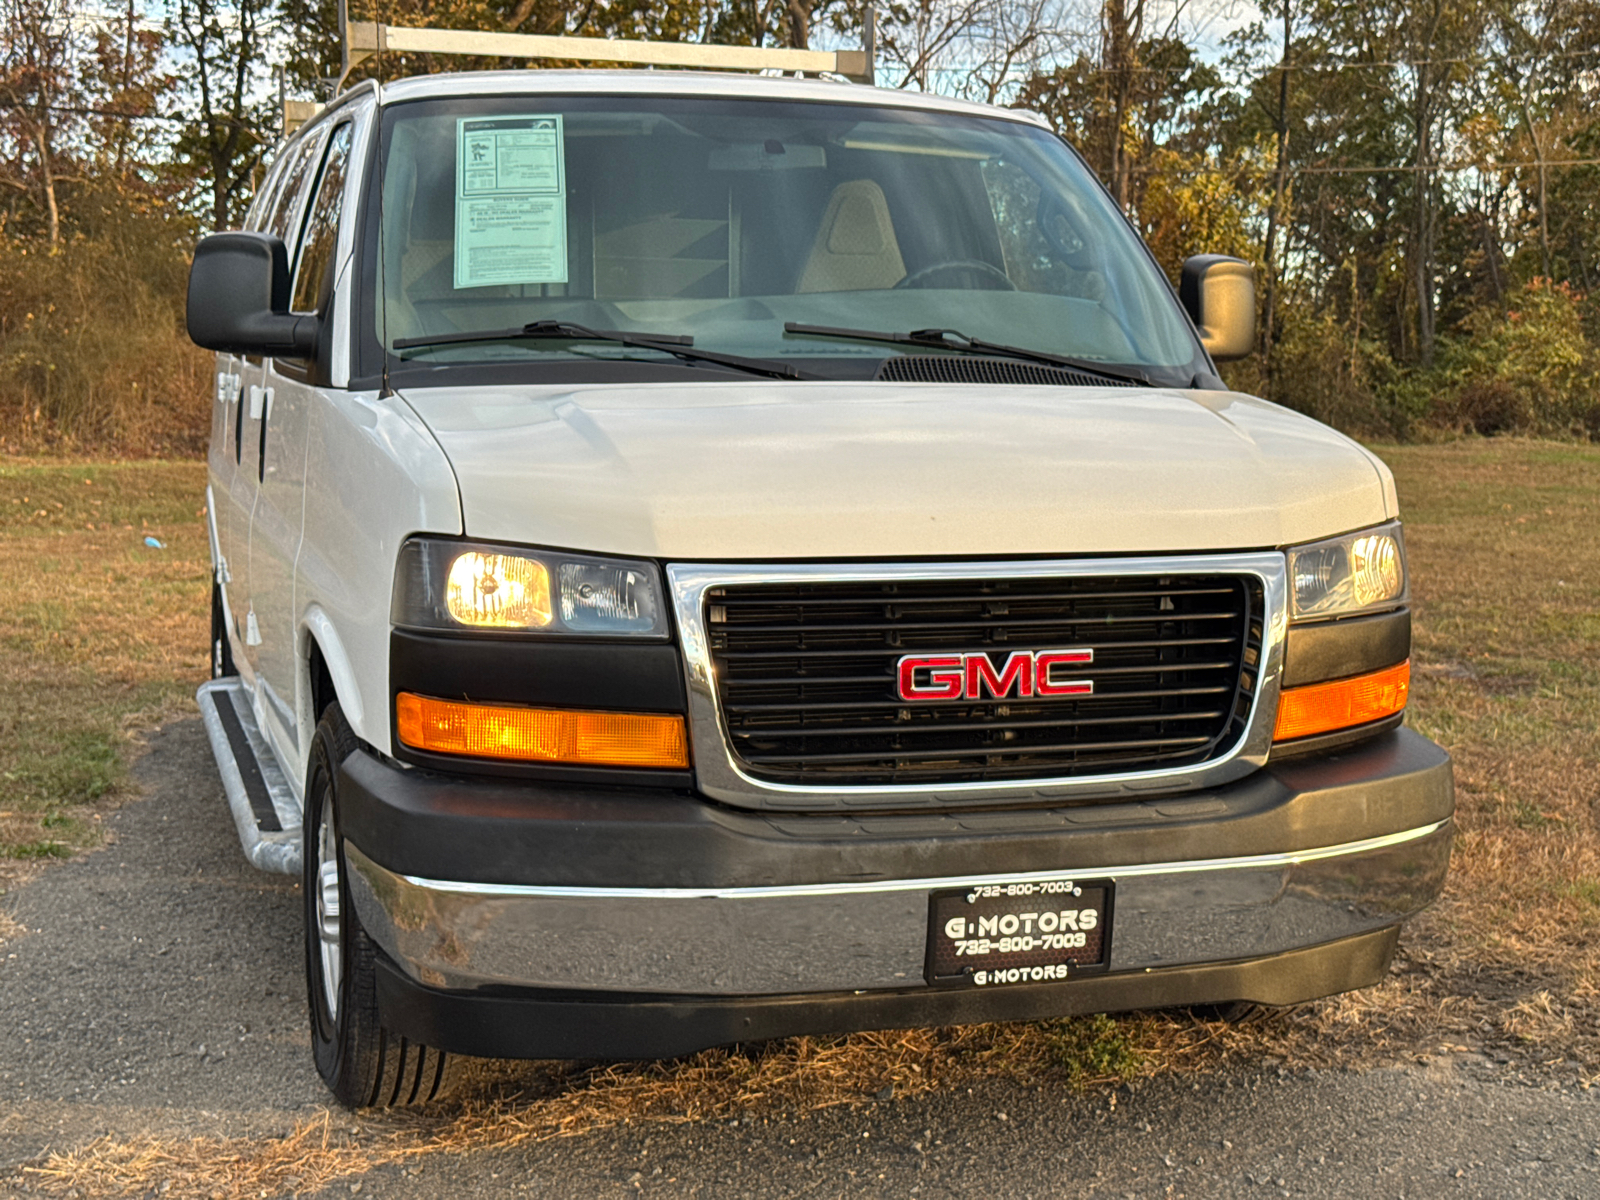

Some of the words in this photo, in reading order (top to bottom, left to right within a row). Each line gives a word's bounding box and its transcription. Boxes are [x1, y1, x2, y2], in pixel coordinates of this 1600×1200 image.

[897, 648, 1094, 701] GMC
[973, 881, 1073, 898] 732-800-7003
[954, 932, 1087, 957] 732-800-7003
